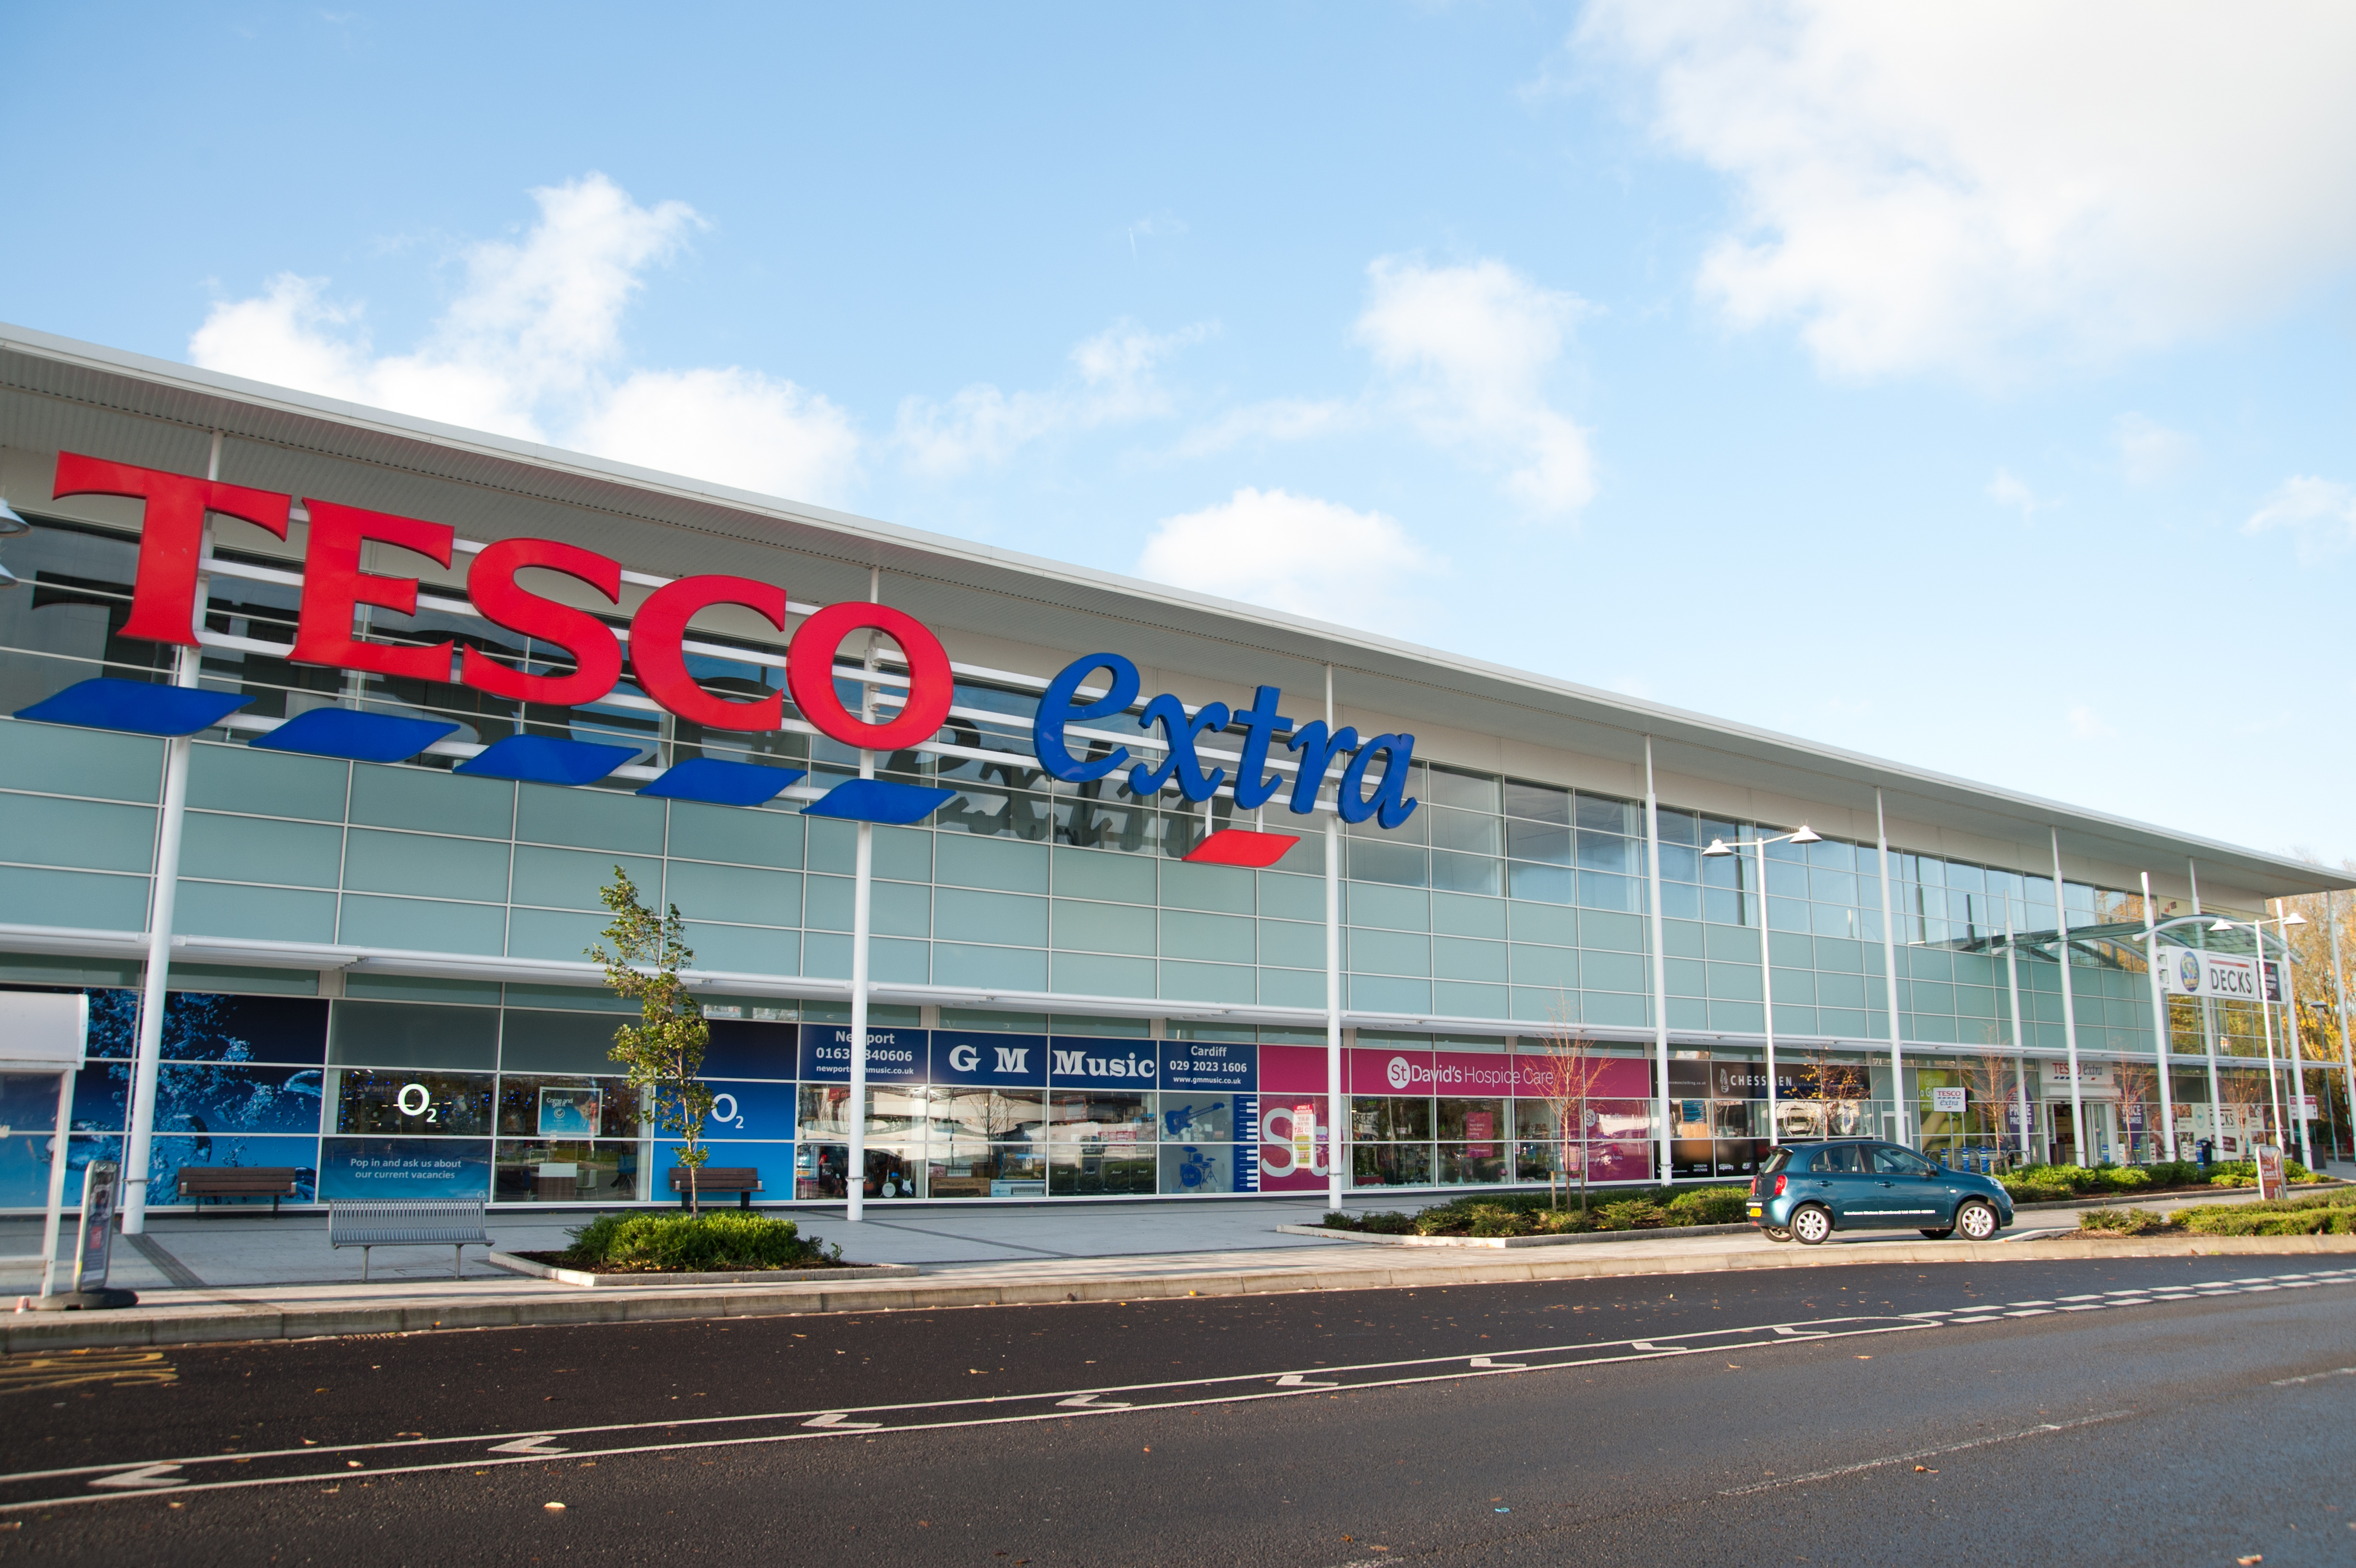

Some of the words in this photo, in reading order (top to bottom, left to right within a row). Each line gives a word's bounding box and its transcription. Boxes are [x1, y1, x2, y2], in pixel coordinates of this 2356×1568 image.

[52, 450, 954, 751] TESCO
[1033, 652, 1418, 829] extra
[2210, 968, 2252, 994] DECKS
[836, 1031, 895, 1045] Neport
[816, 1047, 850, 1059] 0163
[1191, 1045, 1227, 1057] Cardiff
[949, 1045, 981, 1072] G
[993, 1047, 1029, 1073] M
[1052, 1050, 1155, 1078] Music
[1170, 1060, 1189, 1071] 029
[1193, 1061, 1219, 1072] 2023
[1222, 1062, 1247, 1073] 1606
[816, 1065, 914, 1075] newportmusic.co.uk
[2052, 1063, 2081, 1075] TESO
[2083, 1064, 2102, 1075] extra
[1173, 1076, 1241, 1085] www.gmmusic.co.uk
[1391, 1064, 1407, 1081] St
[1411, 1065, 1462, 1083] David's
[1465, 1066, 1520, 1088] Hospice
[1523, 1068, 1554, 1085] Care
[1730, 1075, 1792, 1086] CHESSEN
[2009, 1104, 2031, 1116] PRE
[1586, 1113, 1594, 1122] St
[2010, 1116, 2032, 1125] PROSE
[2210, 1113, 2233, 1126] DCKS
[351, 1159, 369, 1169] Pop
[371, 1158, 380, 1167] in
[382, 1159, 400, 1167] and
[403, 1159, 418, 1167] ask
[434, 1159, 462, 1167] about
[411, 1170, 455, 1179] vacancies
